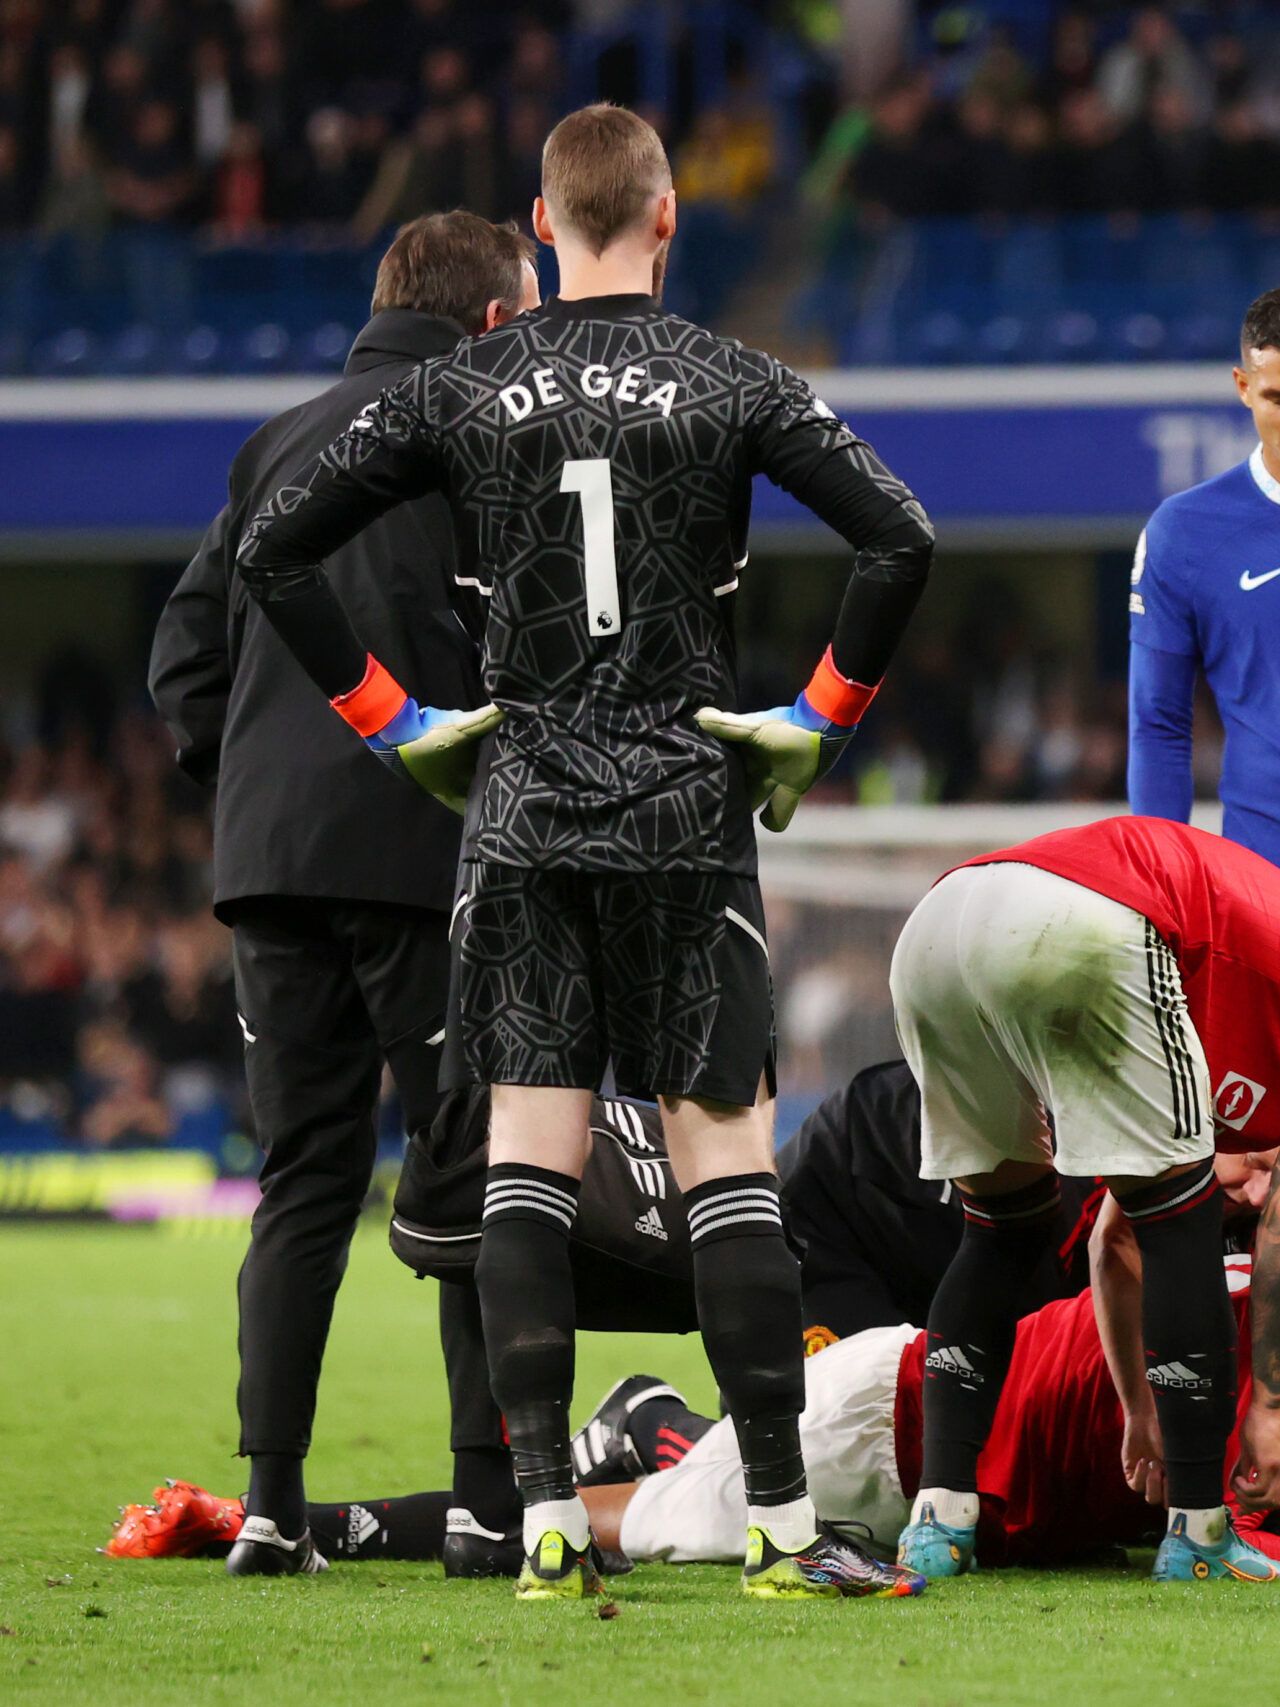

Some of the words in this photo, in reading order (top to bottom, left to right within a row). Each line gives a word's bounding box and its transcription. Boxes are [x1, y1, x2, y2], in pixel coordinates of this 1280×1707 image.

[499, 367, 564, 422] DE
[580, 364, 677, 418] GEA
[559, 458, 622, 637] 1
[634, 1221, 669, 1241] adidas
[925, 1356, 985, 1383] adidas
[1145, 1371, 1213, 1389] adidas
